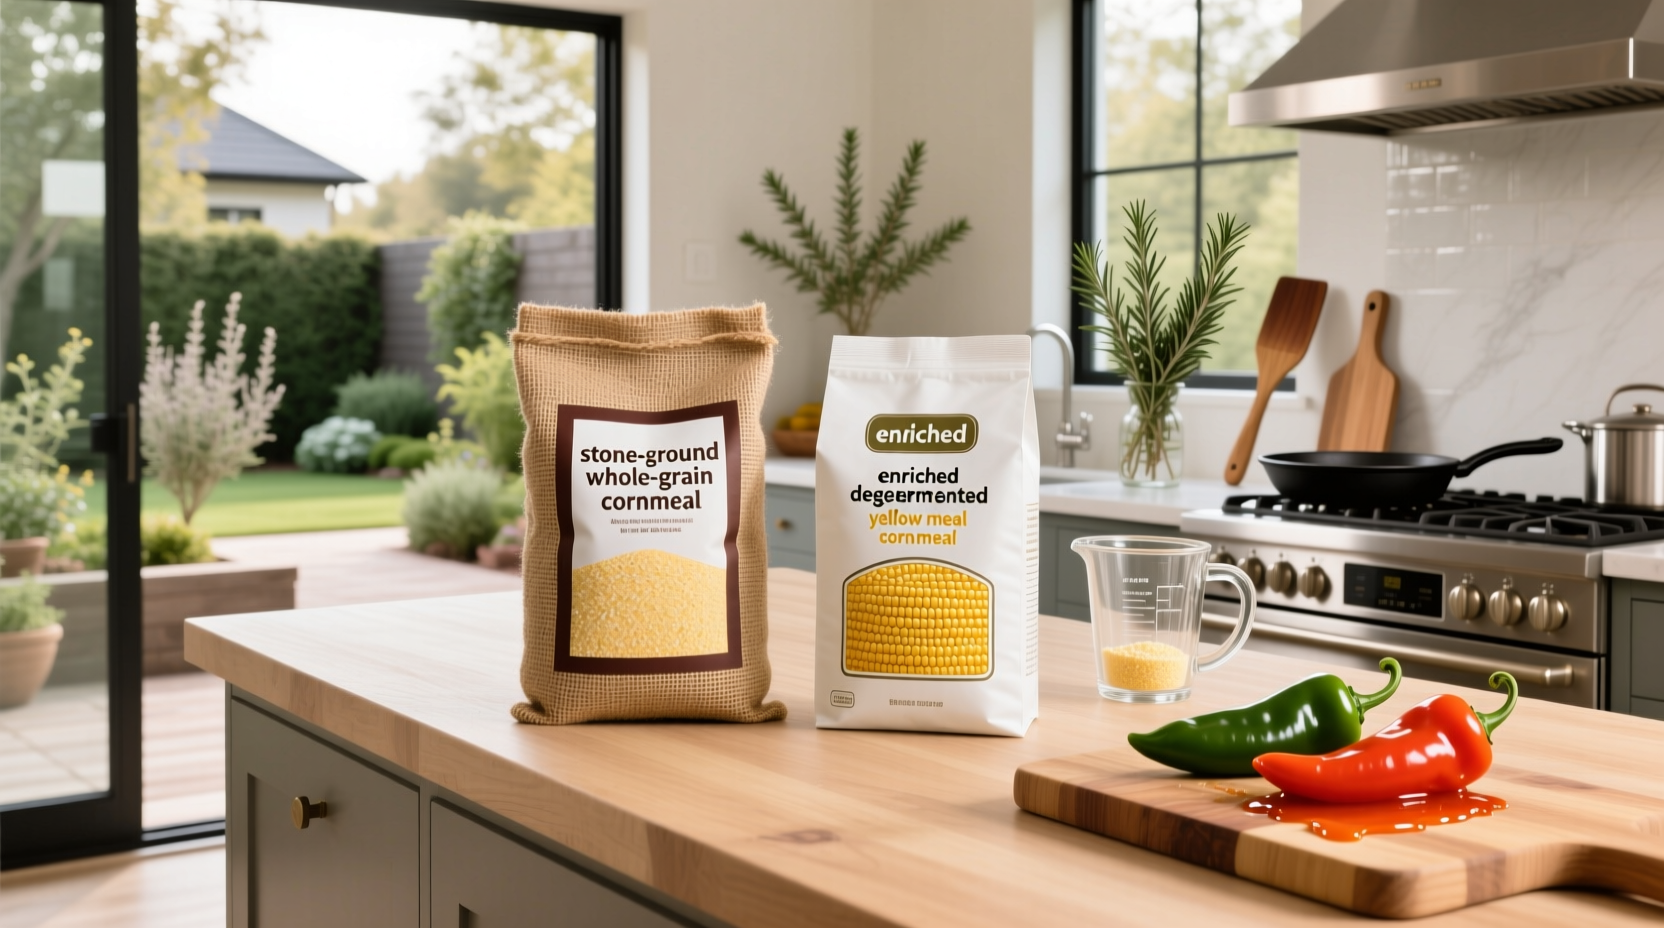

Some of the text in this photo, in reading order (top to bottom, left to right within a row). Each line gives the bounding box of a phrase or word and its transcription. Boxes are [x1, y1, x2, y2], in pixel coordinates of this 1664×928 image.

[875, 422, 968, 443] enriched
[580, 441, 719, 467] stone-ground
[586, 466, 713, 490] whole-grain
[878, 467, 959, 484] enriched
[601, 489, 702, 510] cornmeal
[869, 509, 967, 530] yellow meal
